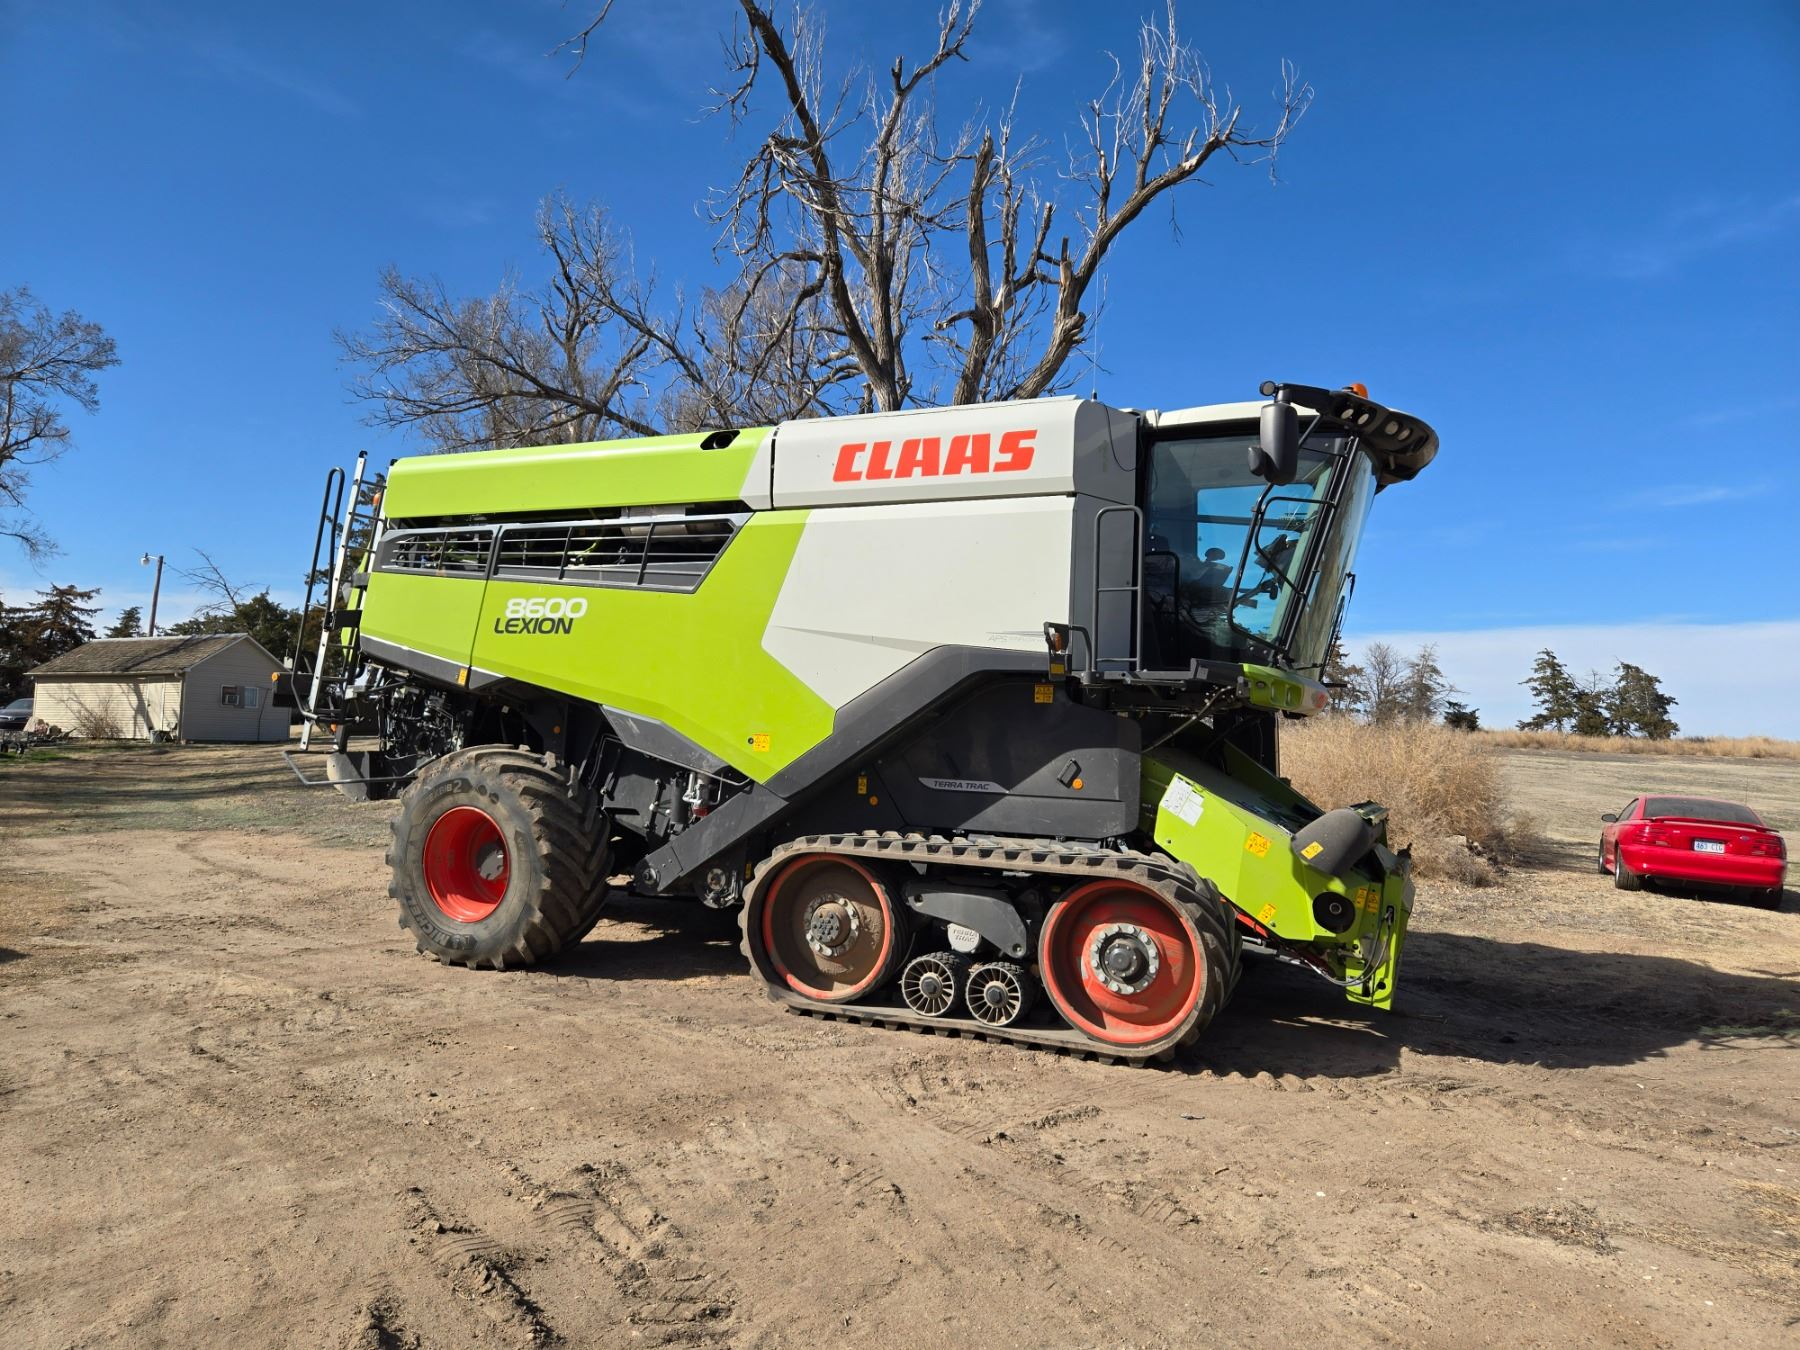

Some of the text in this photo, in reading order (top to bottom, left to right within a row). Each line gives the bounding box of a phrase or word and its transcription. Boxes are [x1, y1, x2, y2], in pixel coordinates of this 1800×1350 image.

[832, 429, 1038, 482] CLAAS
[505, 597, 588, 618] 8600
[494, 617, 574, 635] LEXION
[987, 634, 1008, 642] APS
[452, 779, 463, 794] 2
[933, 780, 990, 790] TERRA TRAC
